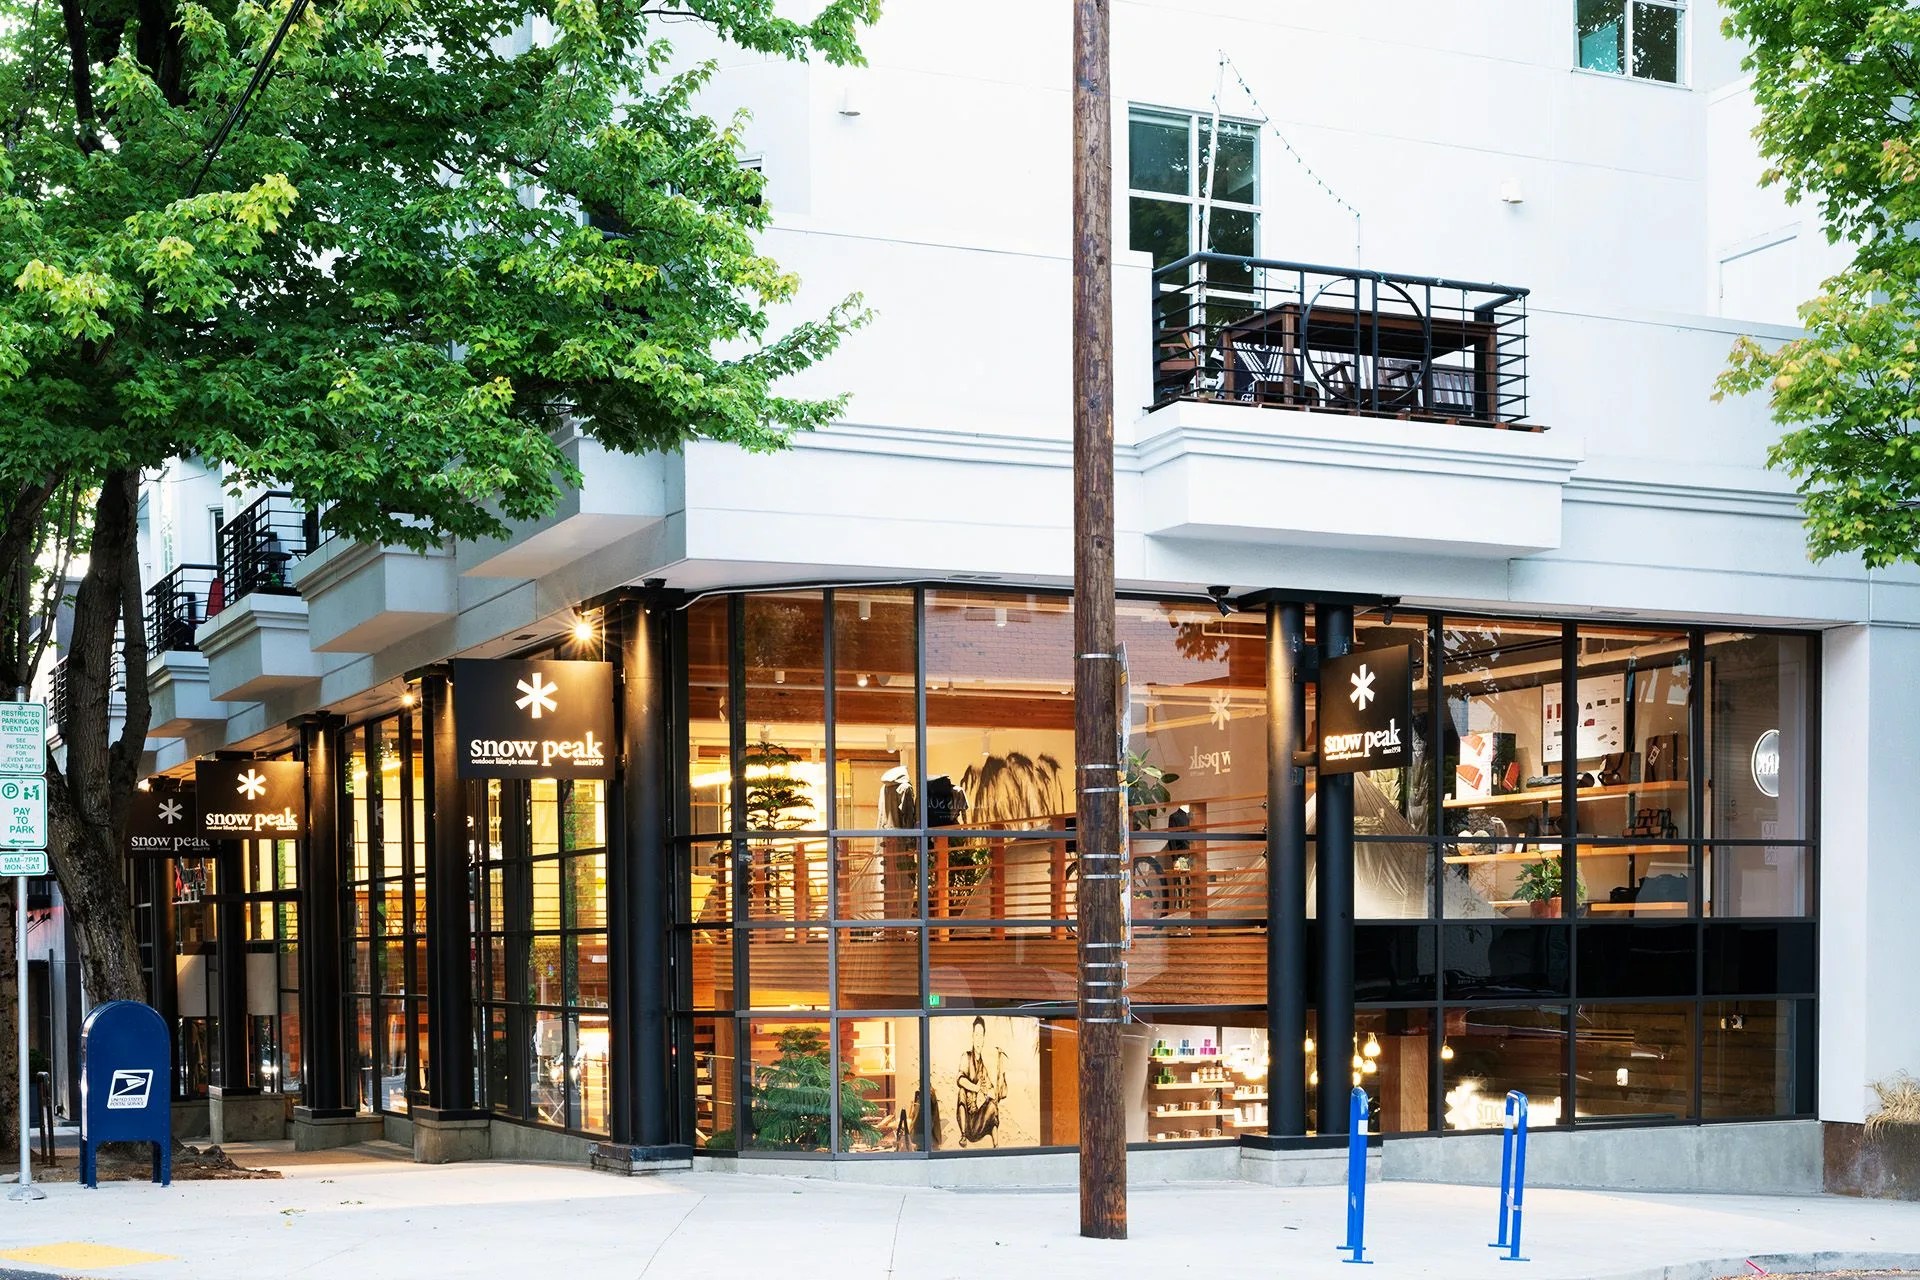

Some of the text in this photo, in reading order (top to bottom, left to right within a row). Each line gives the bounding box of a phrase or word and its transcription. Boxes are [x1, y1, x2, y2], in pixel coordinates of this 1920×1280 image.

[1, 710, 40, 718] RESTRICTED
[1, 717, 29, 725] PARKING
[1, 725, 22, 733] EVENT
[1324, 718, 1402, 758] snow peak
[470, 731, 605, 767] snow peak
[13, 807, 31, 815] PAY
[16, 816, 29, 825] TO
[205, 807, 298, 832] snow peak
[9, 825, 35, 834] PARK
[131, 836, 211, 852] snow peak
